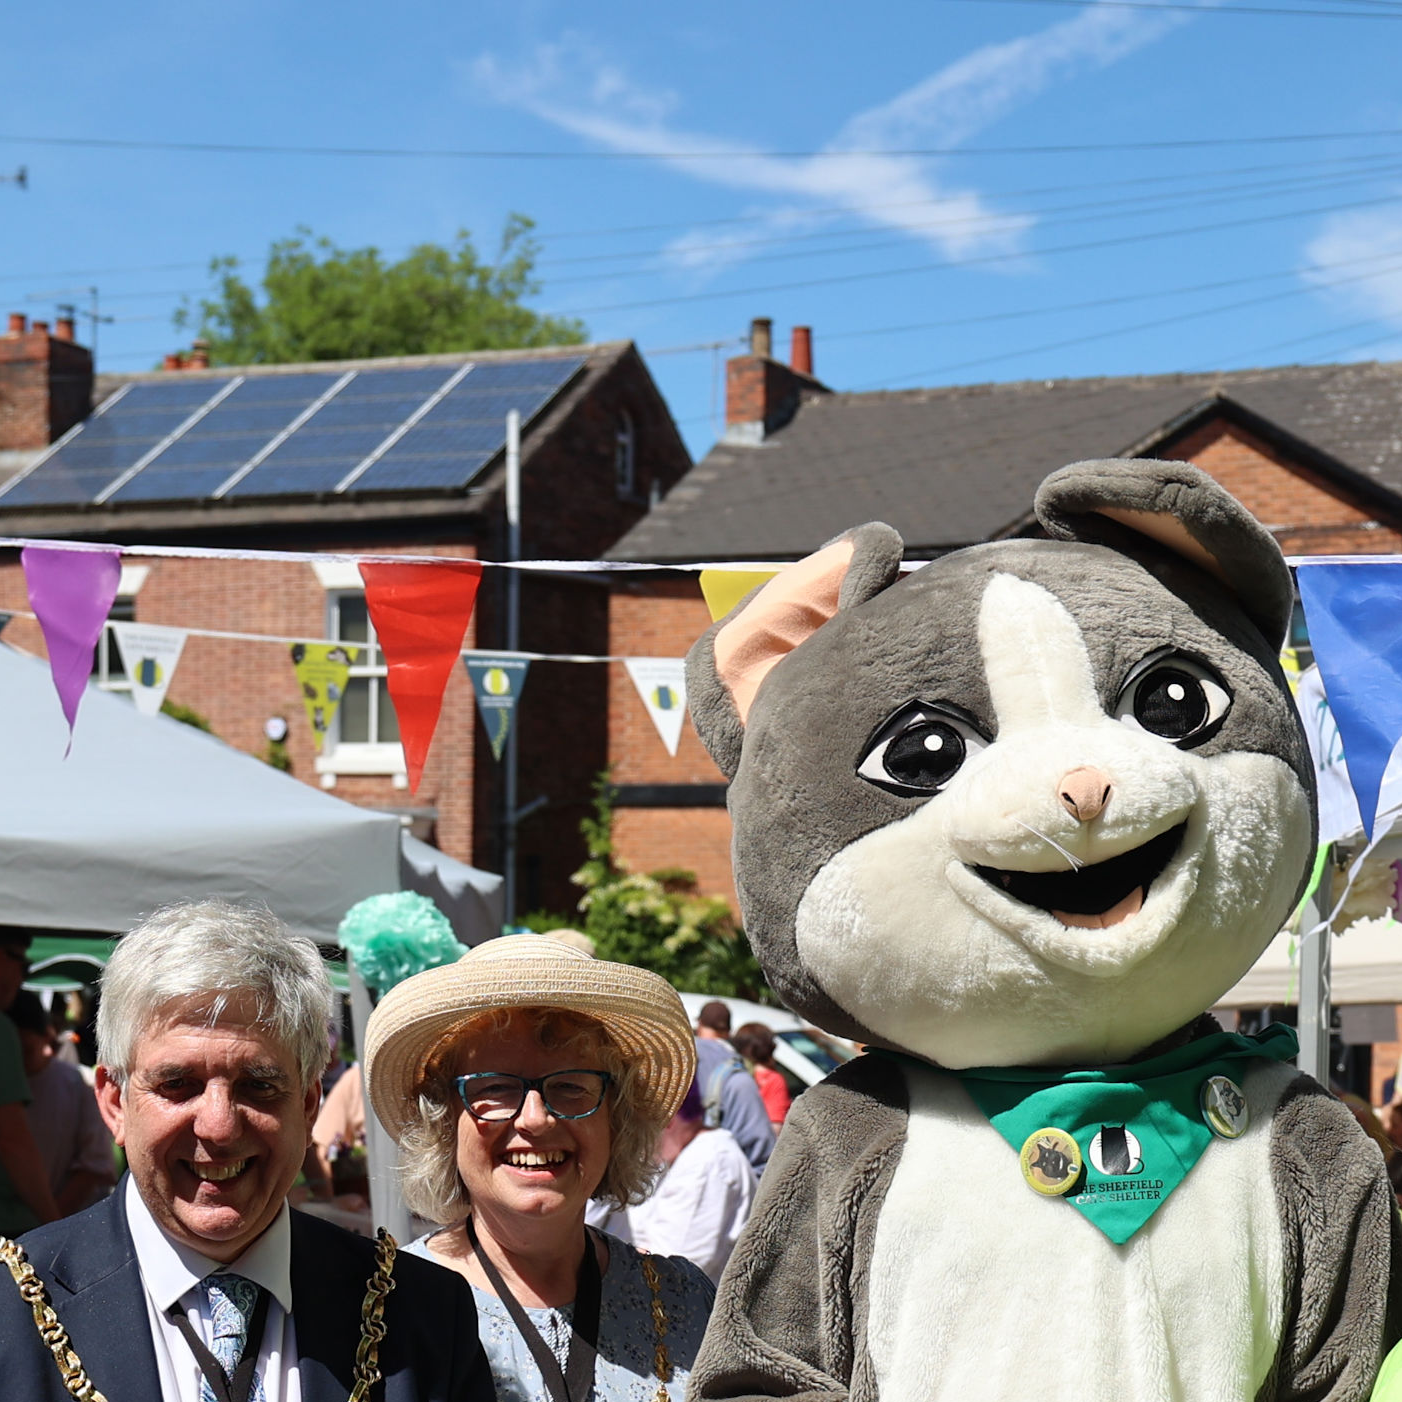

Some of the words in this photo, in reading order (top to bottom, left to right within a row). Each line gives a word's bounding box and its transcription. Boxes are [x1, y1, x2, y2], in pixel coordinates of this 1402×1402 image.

[1098, 1179, 1164, 1192] SHEFFIELD
[1075, 1194, 1107, 1205] CATS
[1109, 1190, 1162, 1204] SHELTER
